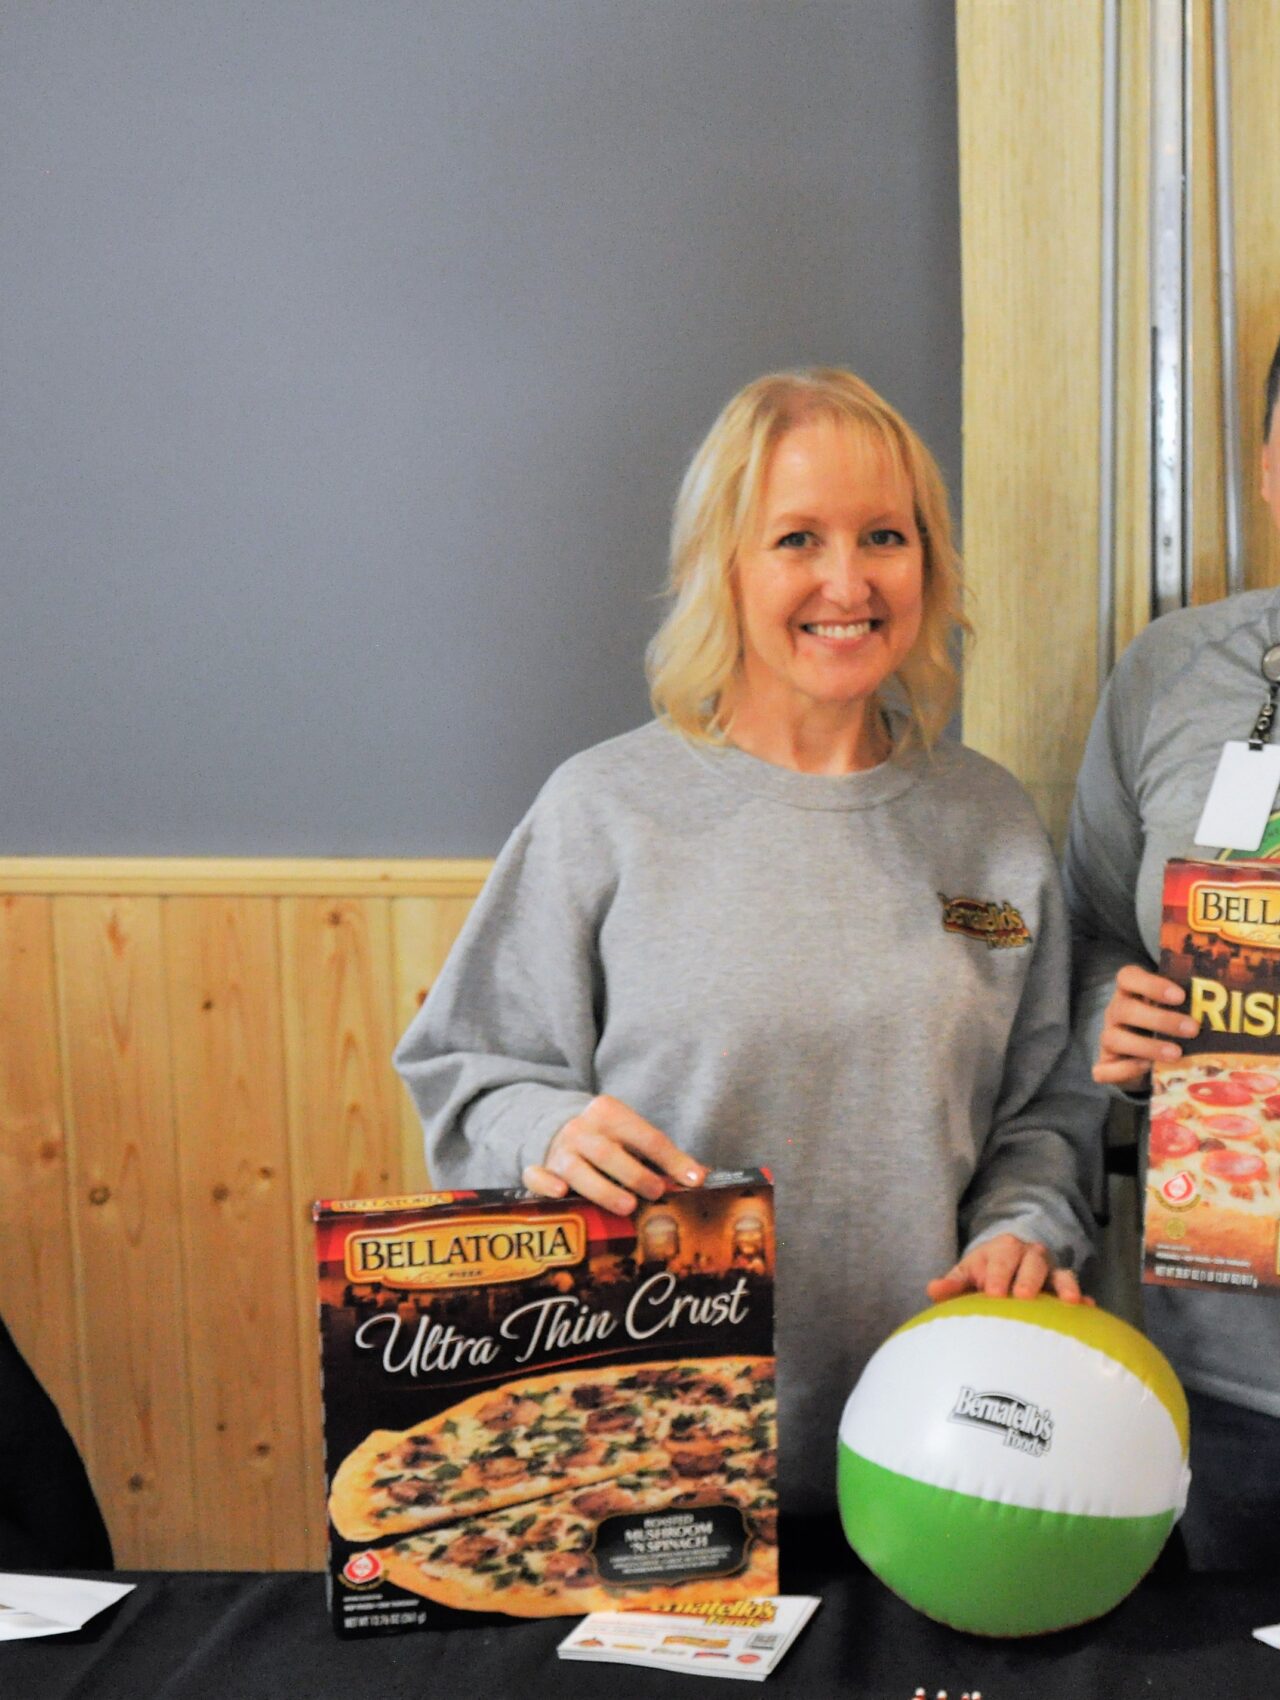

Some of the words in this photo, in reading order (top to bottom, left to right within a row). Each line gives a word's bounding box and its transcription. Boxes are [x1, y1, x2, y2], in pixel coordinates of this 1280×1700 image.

[359, 1226, 574, 1271] BELLATORIA
[355, 1312, 500, 1377] Ultra
[500, 1295, 618, 1363] Thin
[624, 1272, 750, 1340] Crust
[953, 1385, 1054, 1440] Bernatello's
[624, 1521, 714, 1542] MUSHROOM
[647, 1535, 709, 1552] SPINACH
